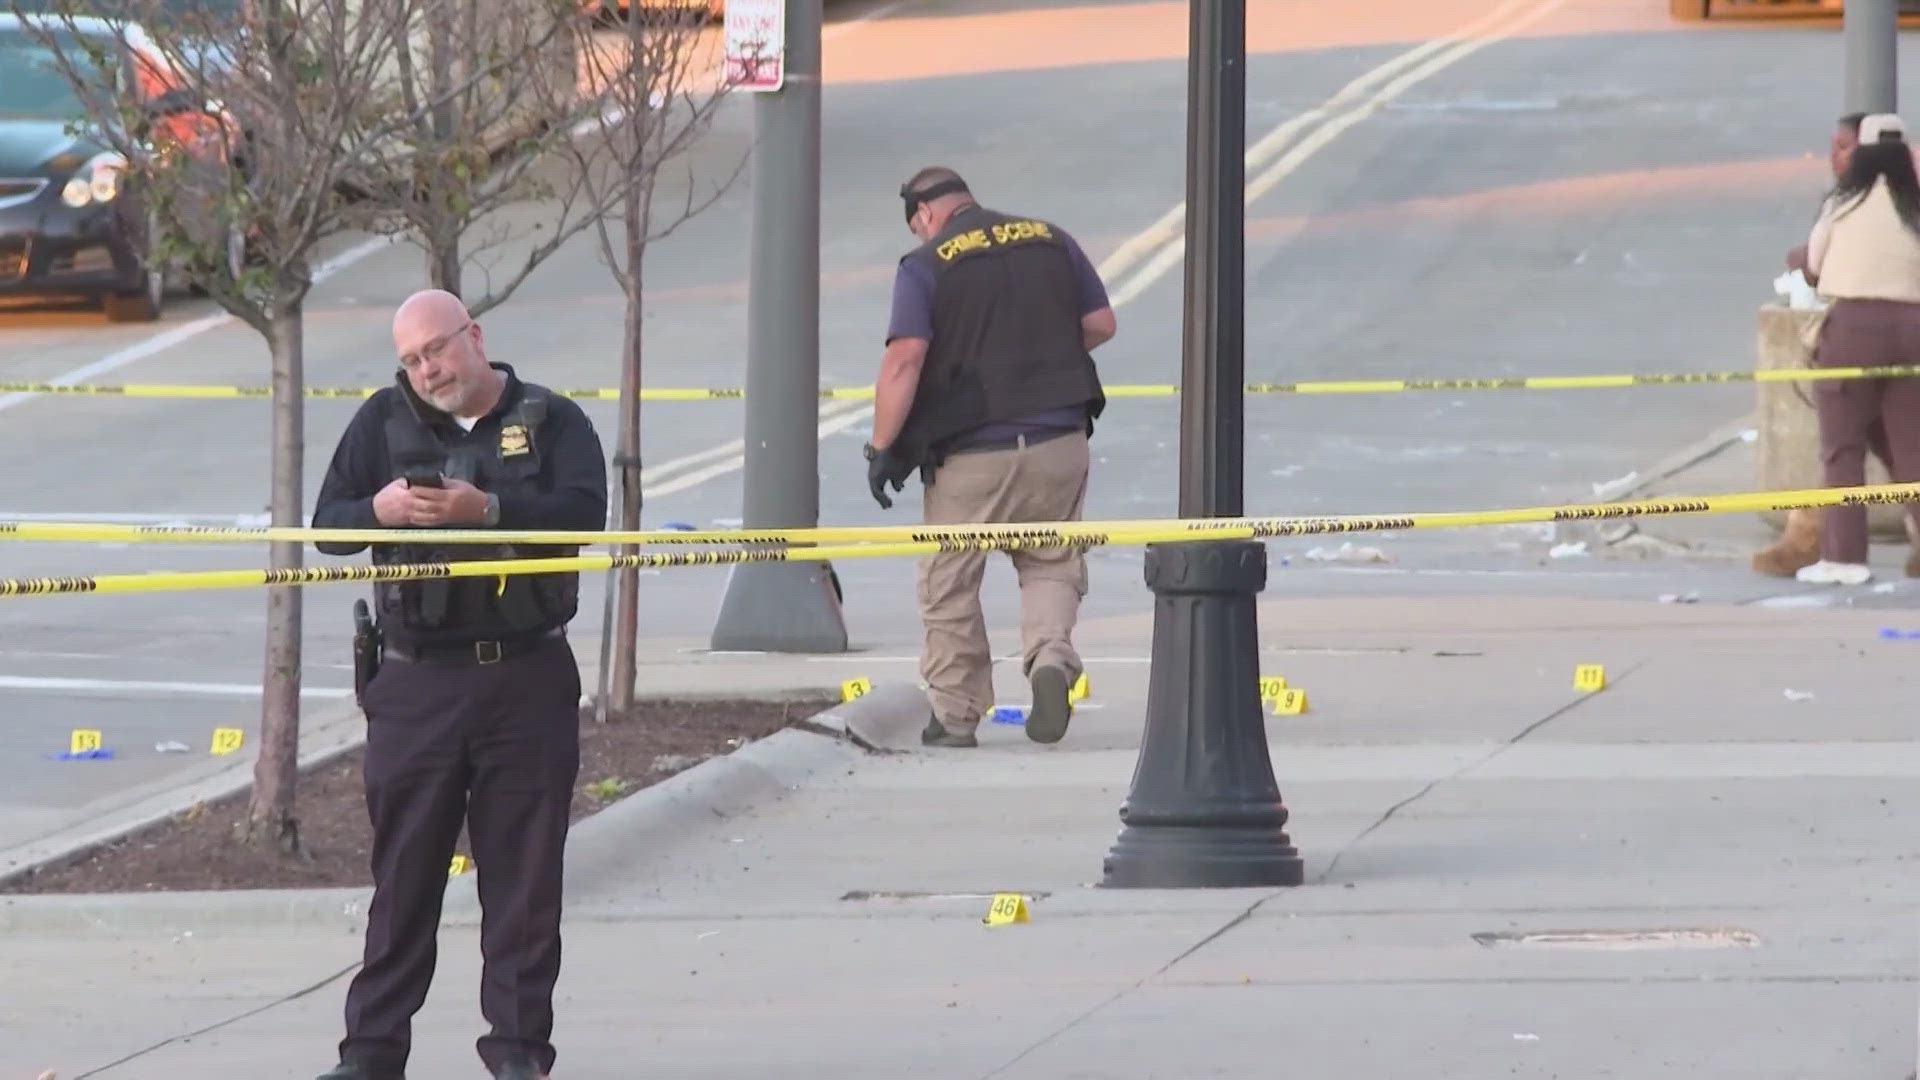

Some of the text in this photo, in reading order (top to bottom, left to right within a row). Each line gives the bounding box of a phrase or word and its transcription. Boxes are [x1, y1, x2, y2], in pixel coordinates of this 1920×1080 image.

[937, 221, 1052, 260] CRIME SCENE
[1583, 669, 1597, 682] 11
[850, 681, 864, 698] 3
[1261, 681, 1280, 697] 10
[1285, 691, 1295, 708] 9
[77, 733, 97, 750] 13
[219, 732, 238, 748] 12
[993, 897, 1017, 916] 46
